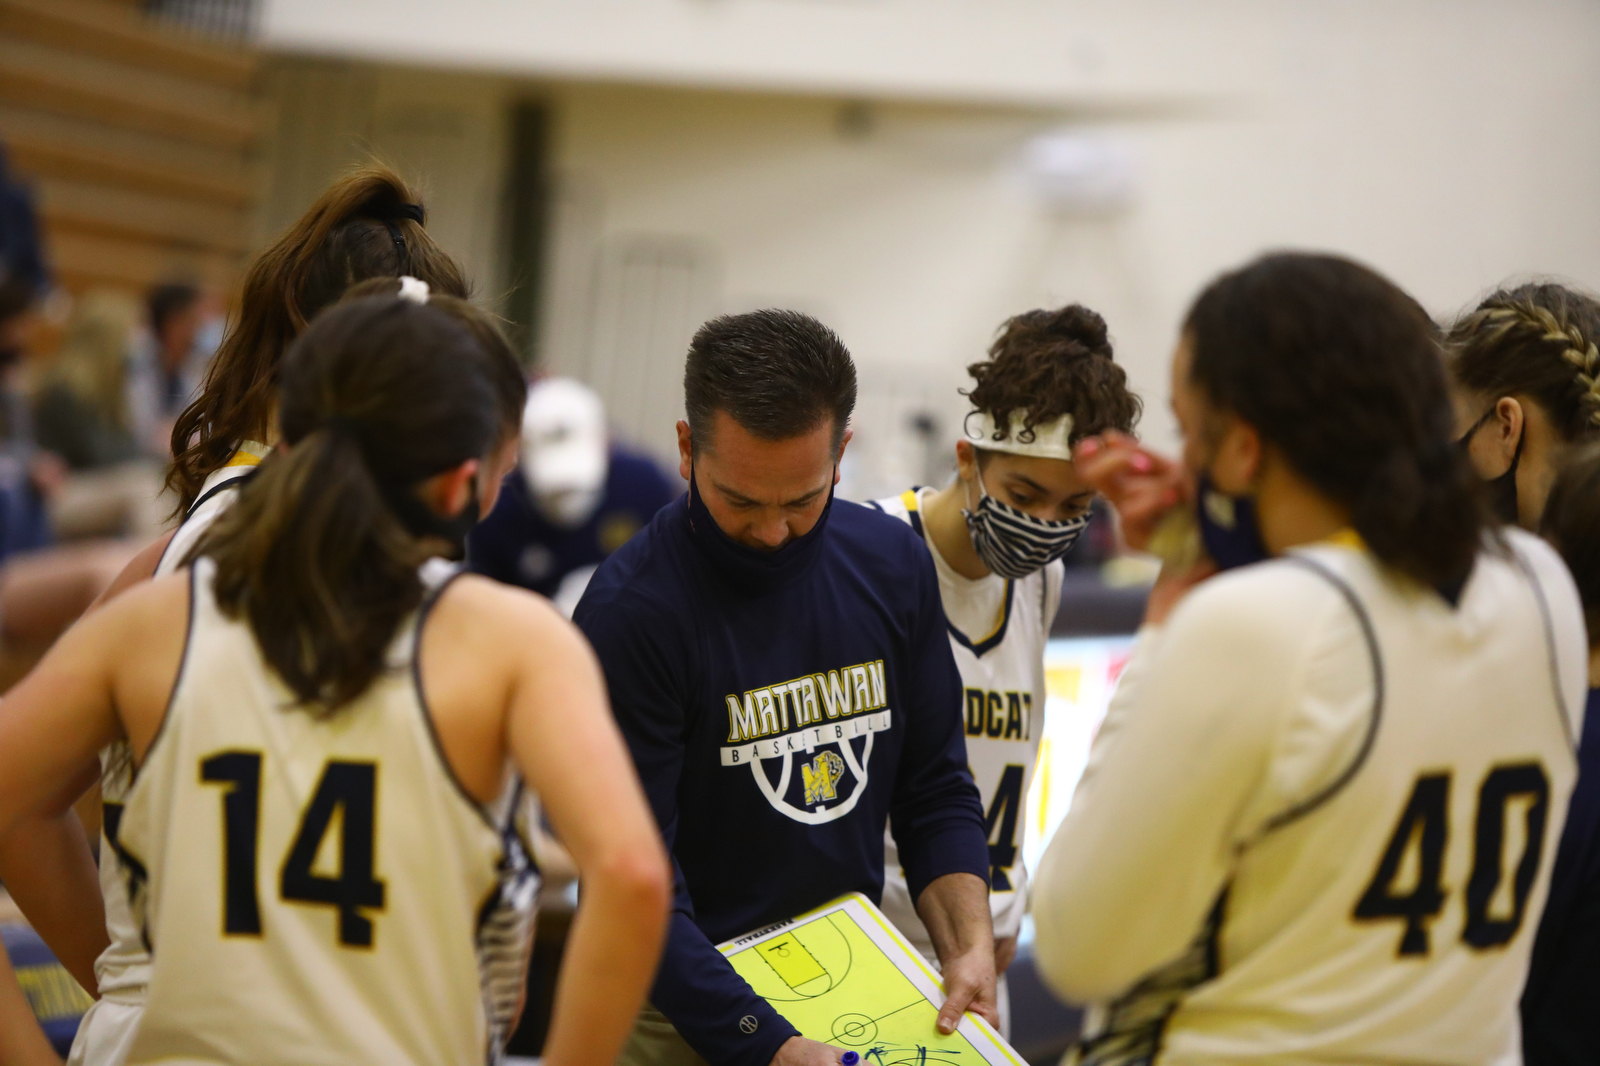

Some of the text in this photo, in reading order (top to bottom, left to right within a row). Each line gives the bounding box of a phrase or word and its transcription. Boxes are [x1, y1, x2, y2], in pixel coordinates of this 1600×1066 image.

[725, 659, 887, 743] MATTAWAN
[199, 748, 388, 951] 14
[1350, 758, 1551, 960] 40
